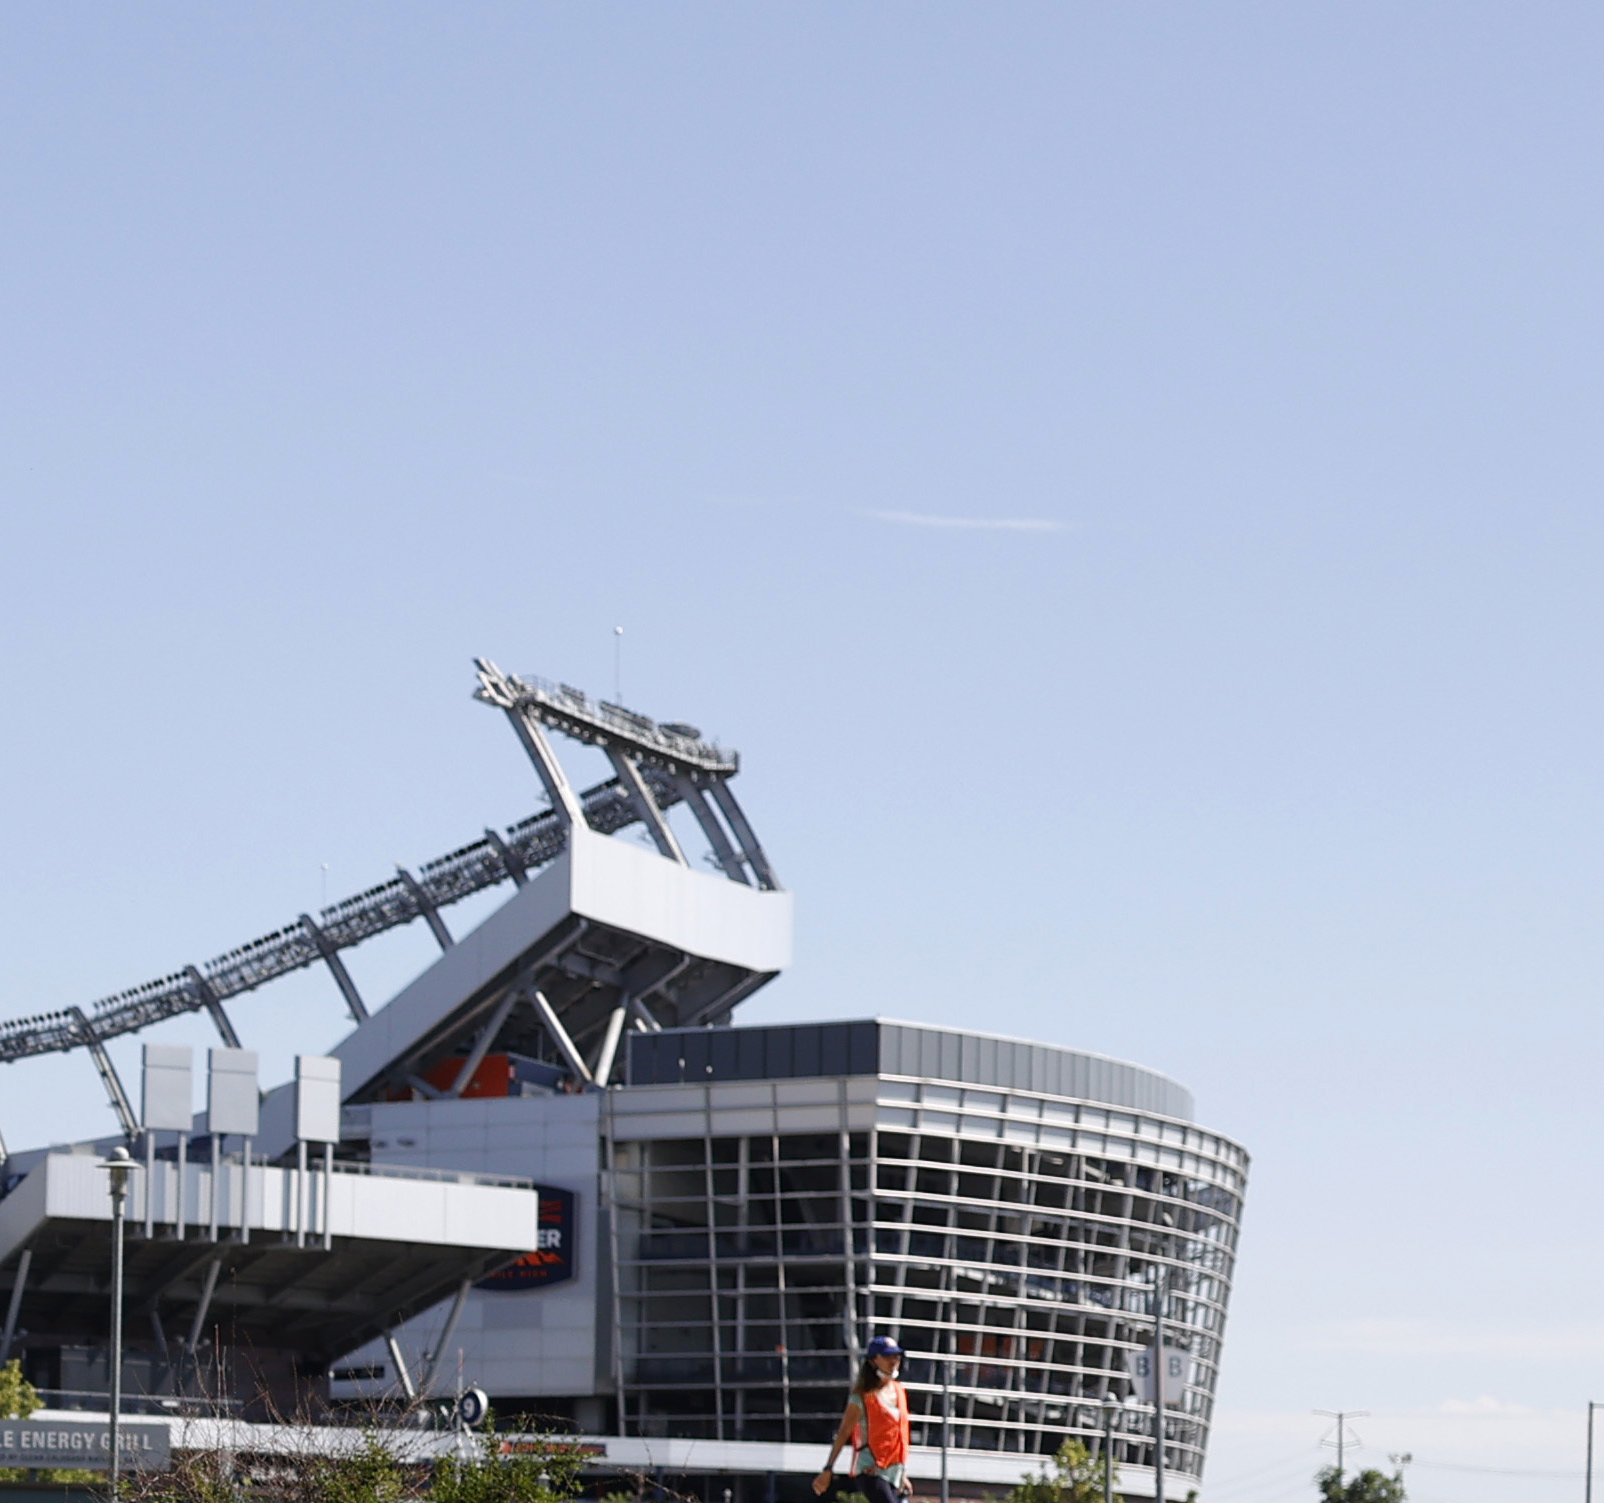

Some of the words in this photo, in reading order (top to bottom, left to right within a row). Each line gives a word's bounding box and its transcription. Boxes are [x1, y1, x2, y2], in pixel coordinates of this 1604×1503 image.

[1136, 1356, 1150, 1378] B
[1169, 1356, 1182, 1378] B
[21, 1430, 95, 1450] ENERGY
